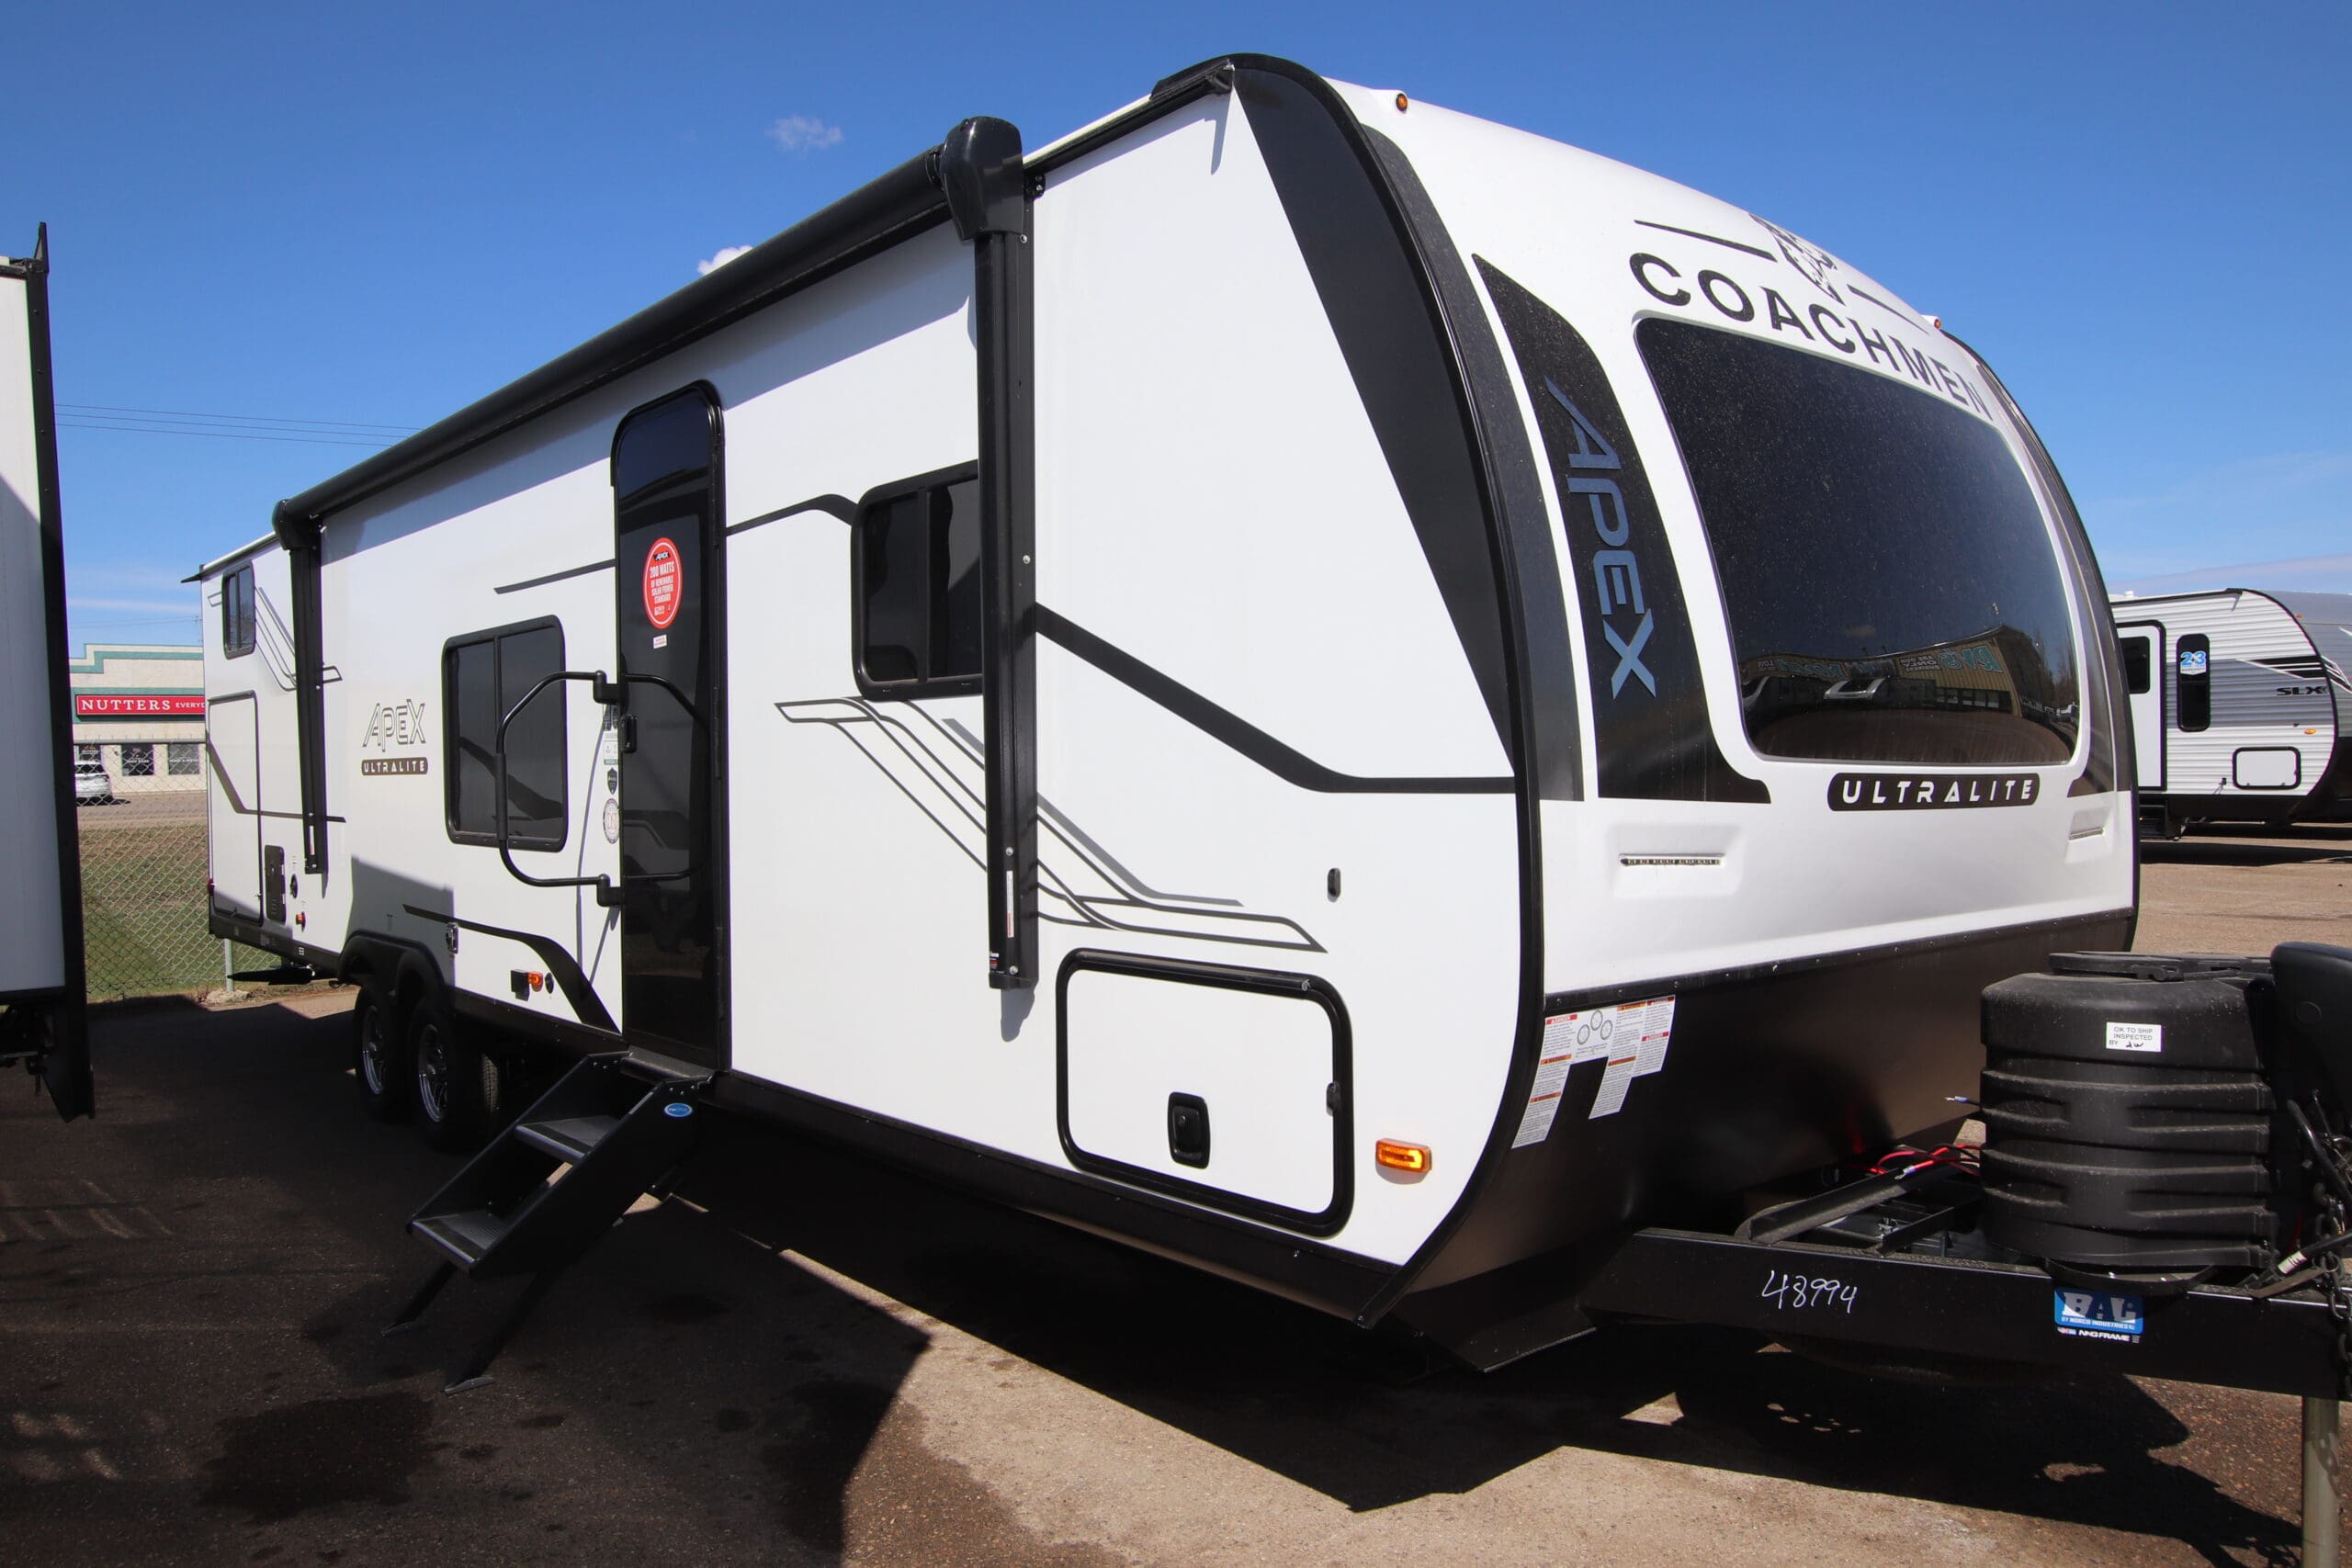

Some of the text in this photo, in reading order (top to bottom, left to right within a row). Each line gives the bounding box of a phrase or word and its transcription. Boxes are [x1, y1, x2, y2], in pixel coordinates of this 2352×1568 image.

[1629, 253, 1993, 422] COACHMEN
[1544, 375, 1657, 700] APEX
[660, 561, 675, 576] WATTS
[2277, 685, 2328, 696] SLX
[81, 699, 171, 711] NUTTERS
[362, 698, 426, 752] APEX
[363, 761, 425, 773] ULTRALITE
[1842, 779, 2033, 805] ULTRALITE
[1761, 1269, 1858, 1314] 48994
[2063, 1292, 2137, 1324] BAL
[2091, 1320, 2128, 1330] INDUSTRIES
[2098, 1332, 2131, 1342] FRAME
